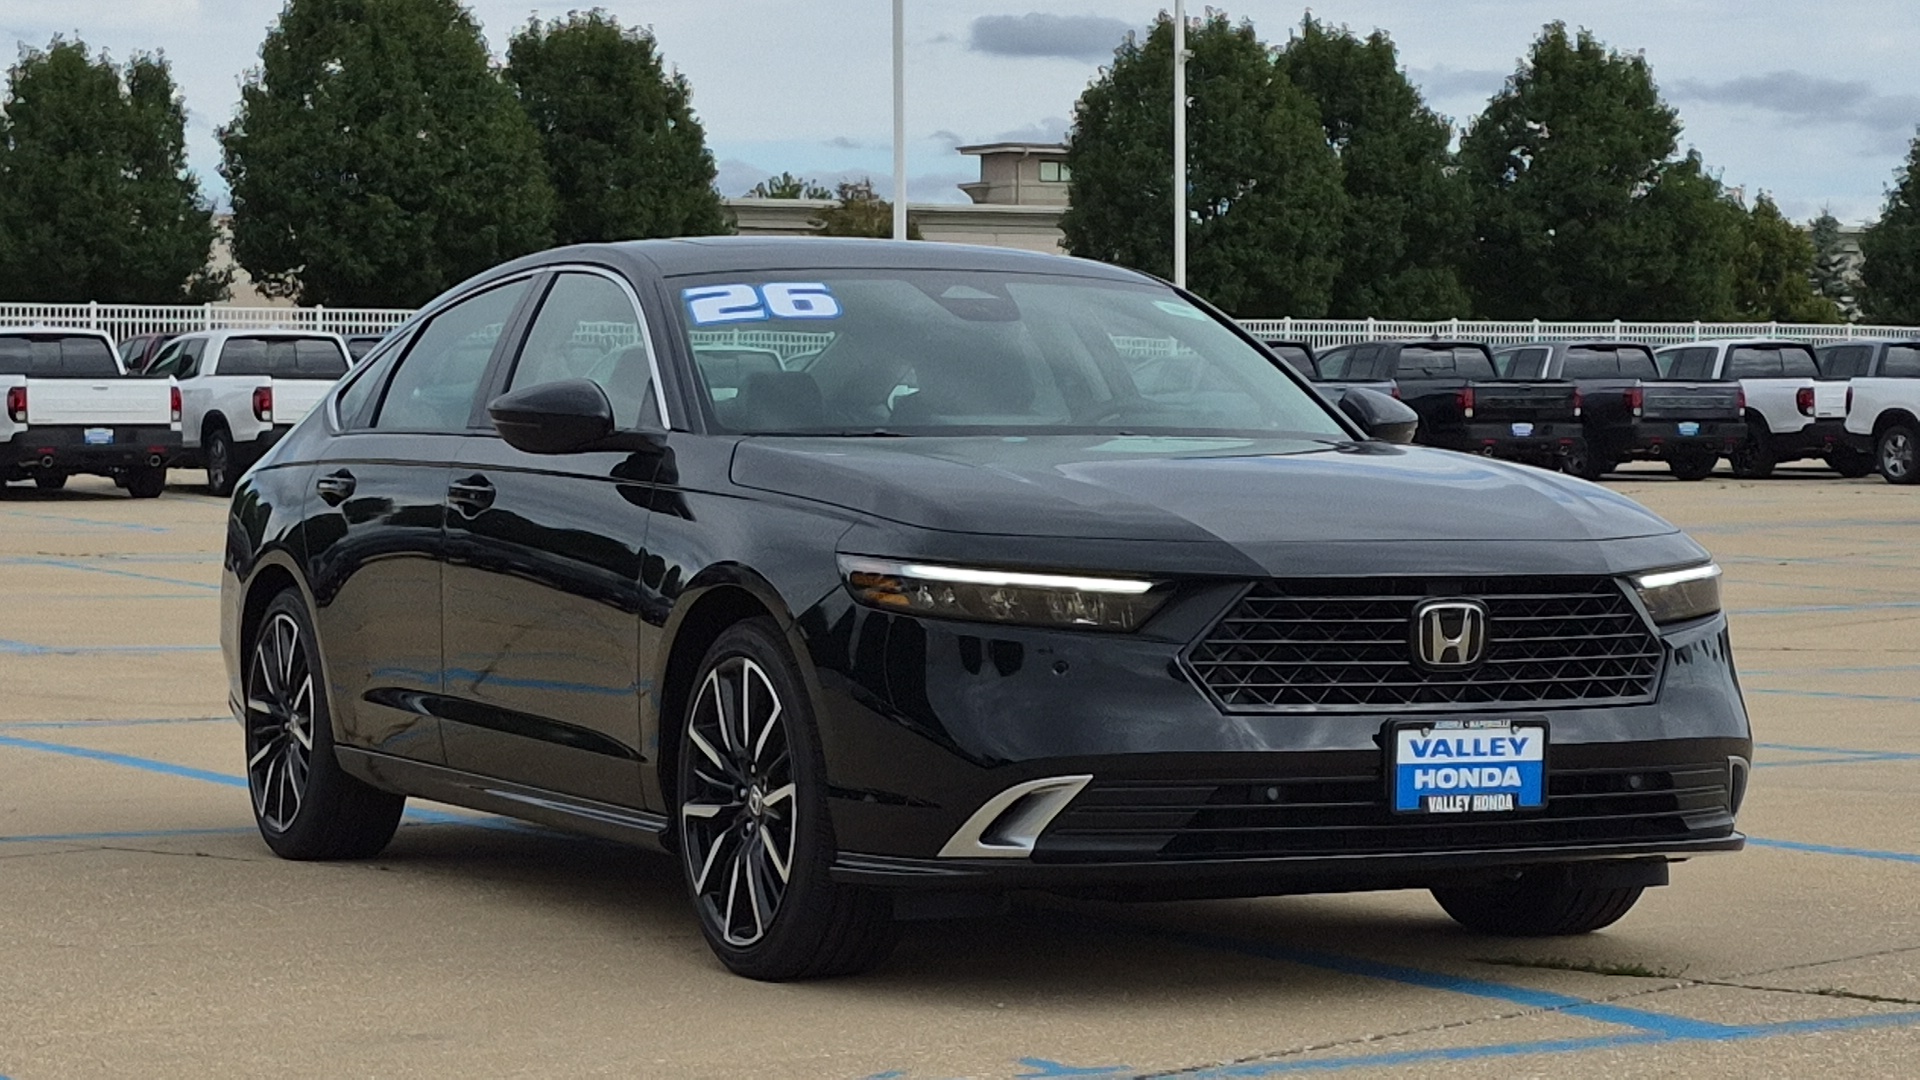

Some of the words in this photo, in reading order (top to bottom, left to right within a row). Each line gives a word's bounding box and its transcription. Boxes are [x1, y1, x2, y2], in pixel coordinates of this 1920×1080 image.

[682, 281, 842, 326] 26
[1409, 737, 1529, 758] VALLEY
[1414, 766, 1522, 790] HONDA
[1428, 796, 1470, 813] VALLEY
[1473, 794, 1514, 812] HONDA
